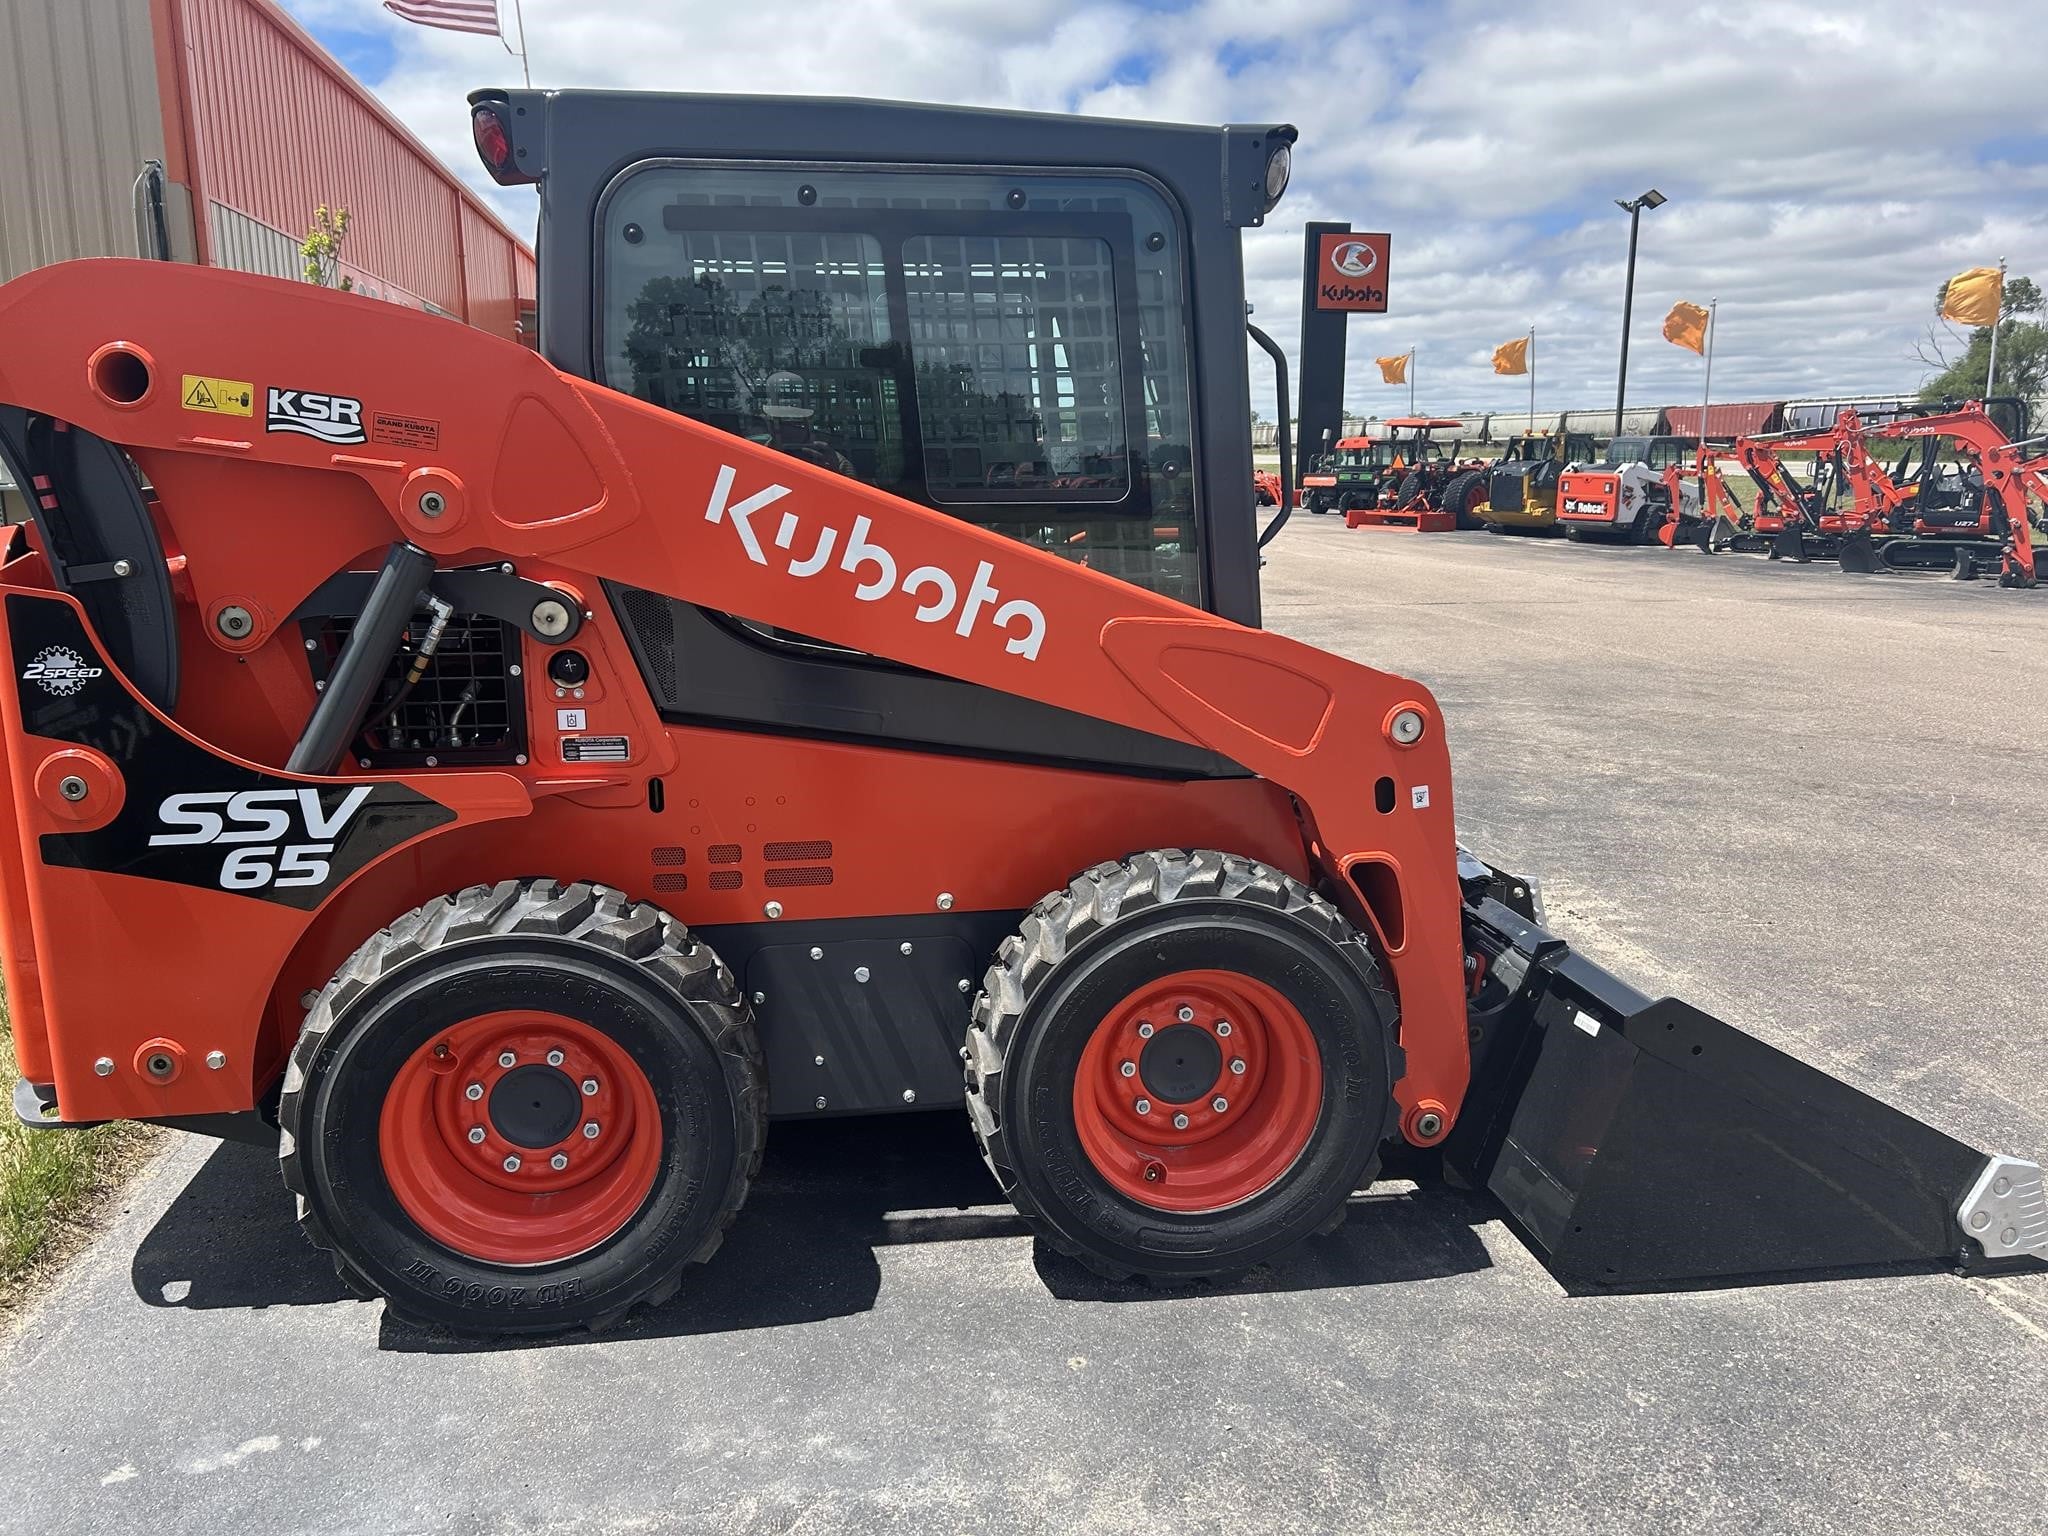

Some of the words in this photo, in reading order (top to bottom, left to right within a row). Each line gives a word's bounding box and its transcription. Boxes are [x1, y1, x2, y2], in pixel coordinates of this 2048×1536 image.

[1322, 285, 1383, 302] Kubota
[269, 389, 361, 423] KSR
[377, 418, 403, 428] GRAND
[404, 423, 435, 433] KUBOTA
[1577, 502, 1607, 514] Bobcat
[704, 464, 1046, 661] Kubota
[148, 786, 374, 846] SSV
[219, 843, 334, 889] 65
[441, 1275, 526, 1306] 2000
